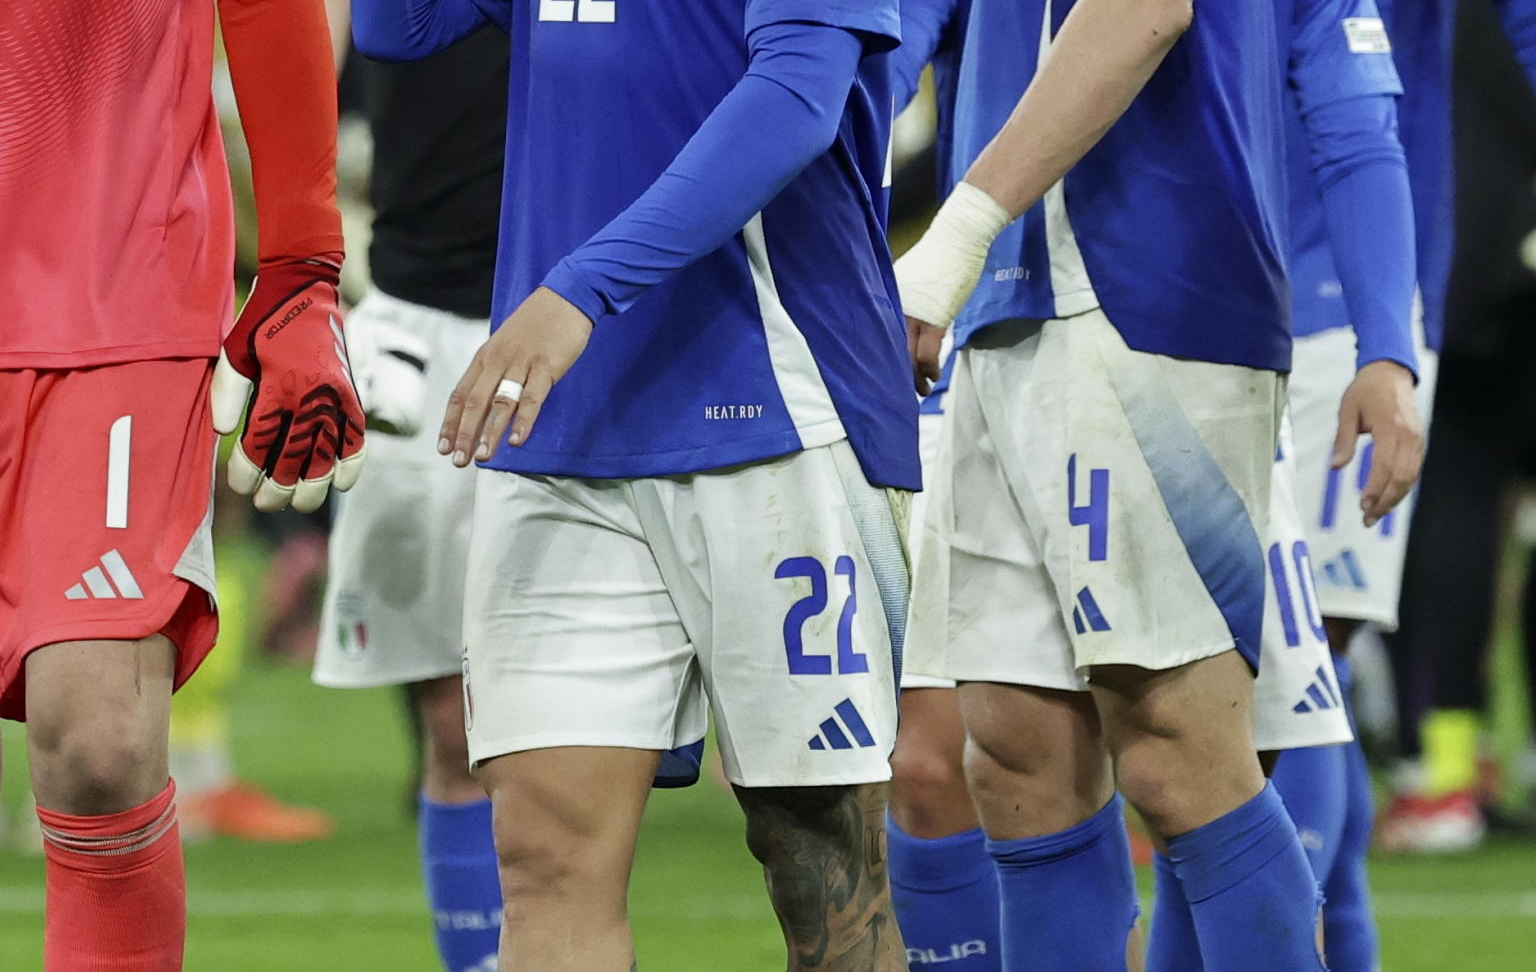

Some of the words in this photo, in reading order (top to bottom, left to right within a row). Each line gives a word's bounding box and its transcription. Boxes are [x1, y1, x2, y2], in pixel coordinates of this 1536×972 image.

[265, 296, 313, 341] PREDATOR
[704, 404, 764, 421] HEAT.RDY
[105, 414, 132, 529] 1
[1067, 452, 1110, 562] 4
[774, 555, 870, 676] 22
[1268, 541, 1329, 647] 10
[905, 939, 987, 964] ALIA
